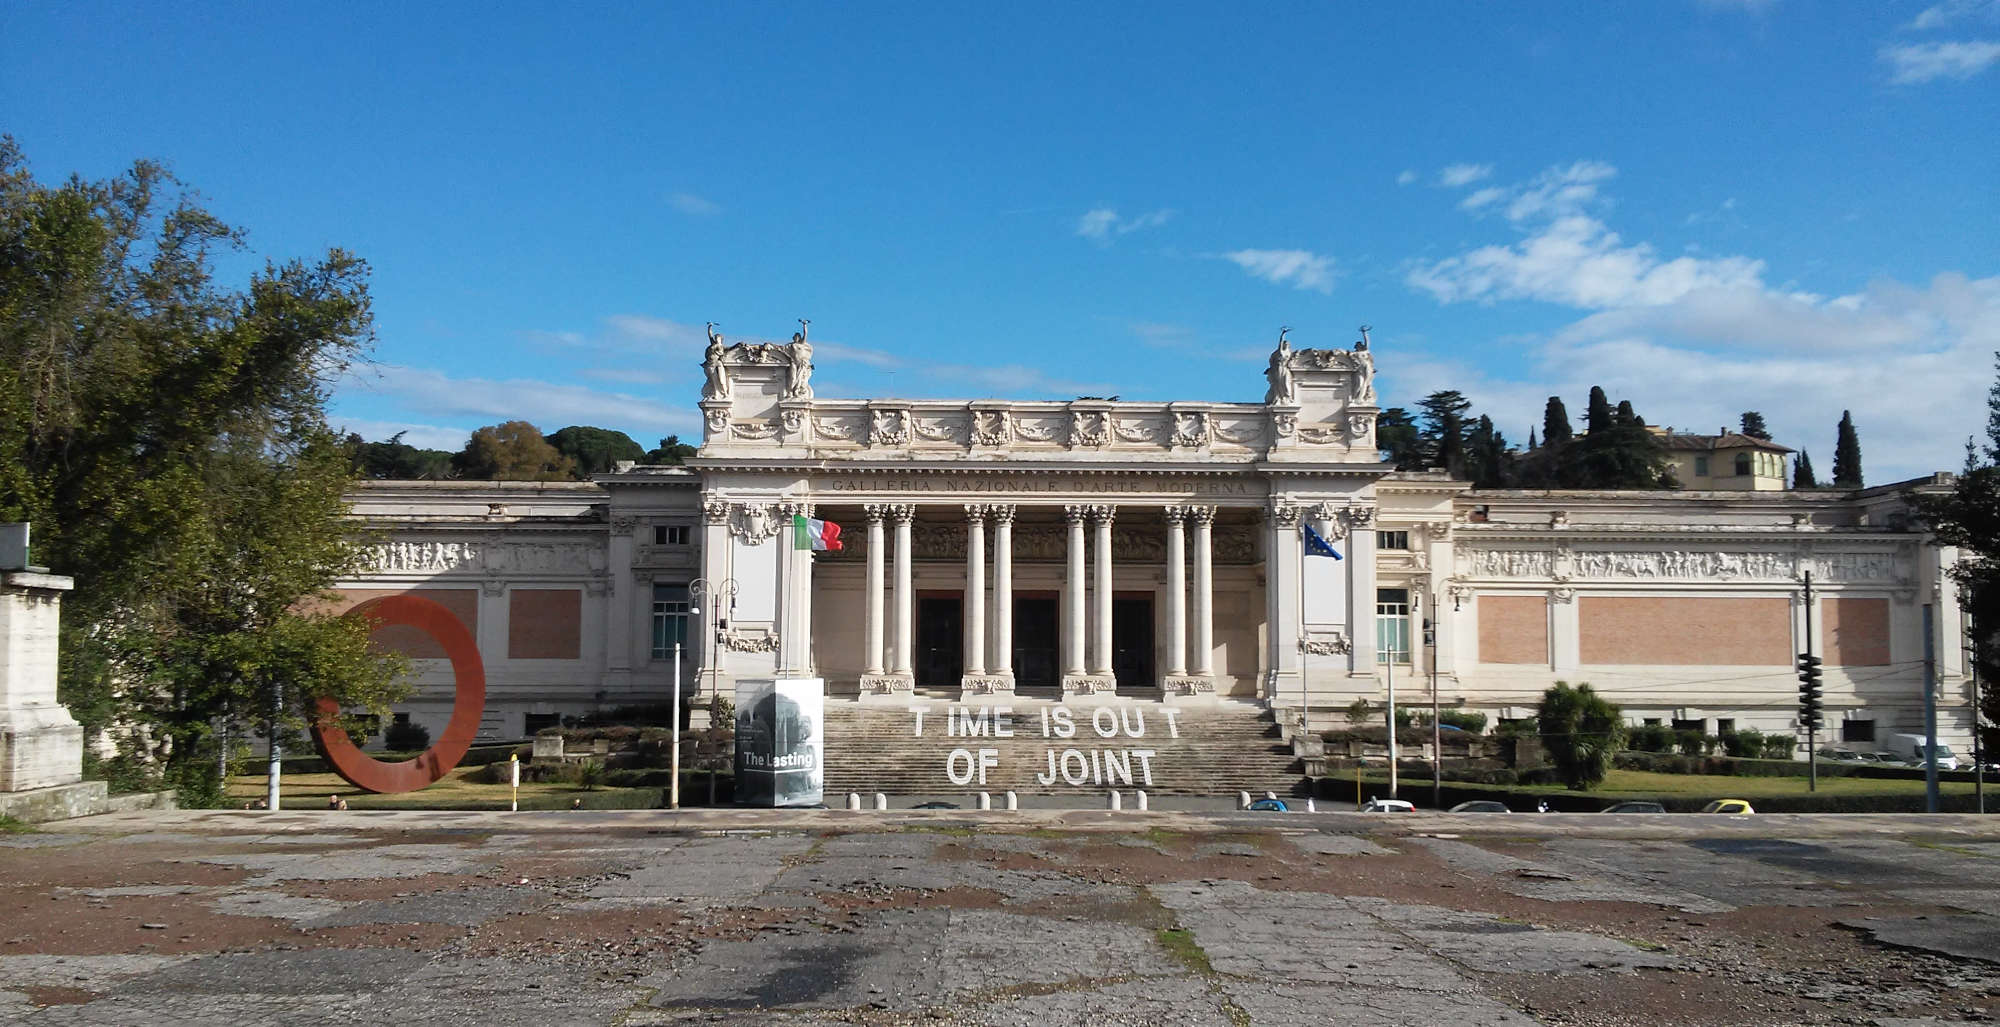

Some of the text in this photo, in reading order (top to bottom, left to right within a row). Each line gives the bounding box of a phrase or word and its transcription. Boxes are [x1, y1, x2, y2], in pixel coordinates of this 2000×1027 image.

[832, 480, 1246, 493] GALLERIA NAZIONALE D'ARTE MODERNA
[909, 705, 1181, 738] TIME IS OUT
[744, 751, 813, 768] The Lasting
[946, 748, 1157, 786] OF JOINT
